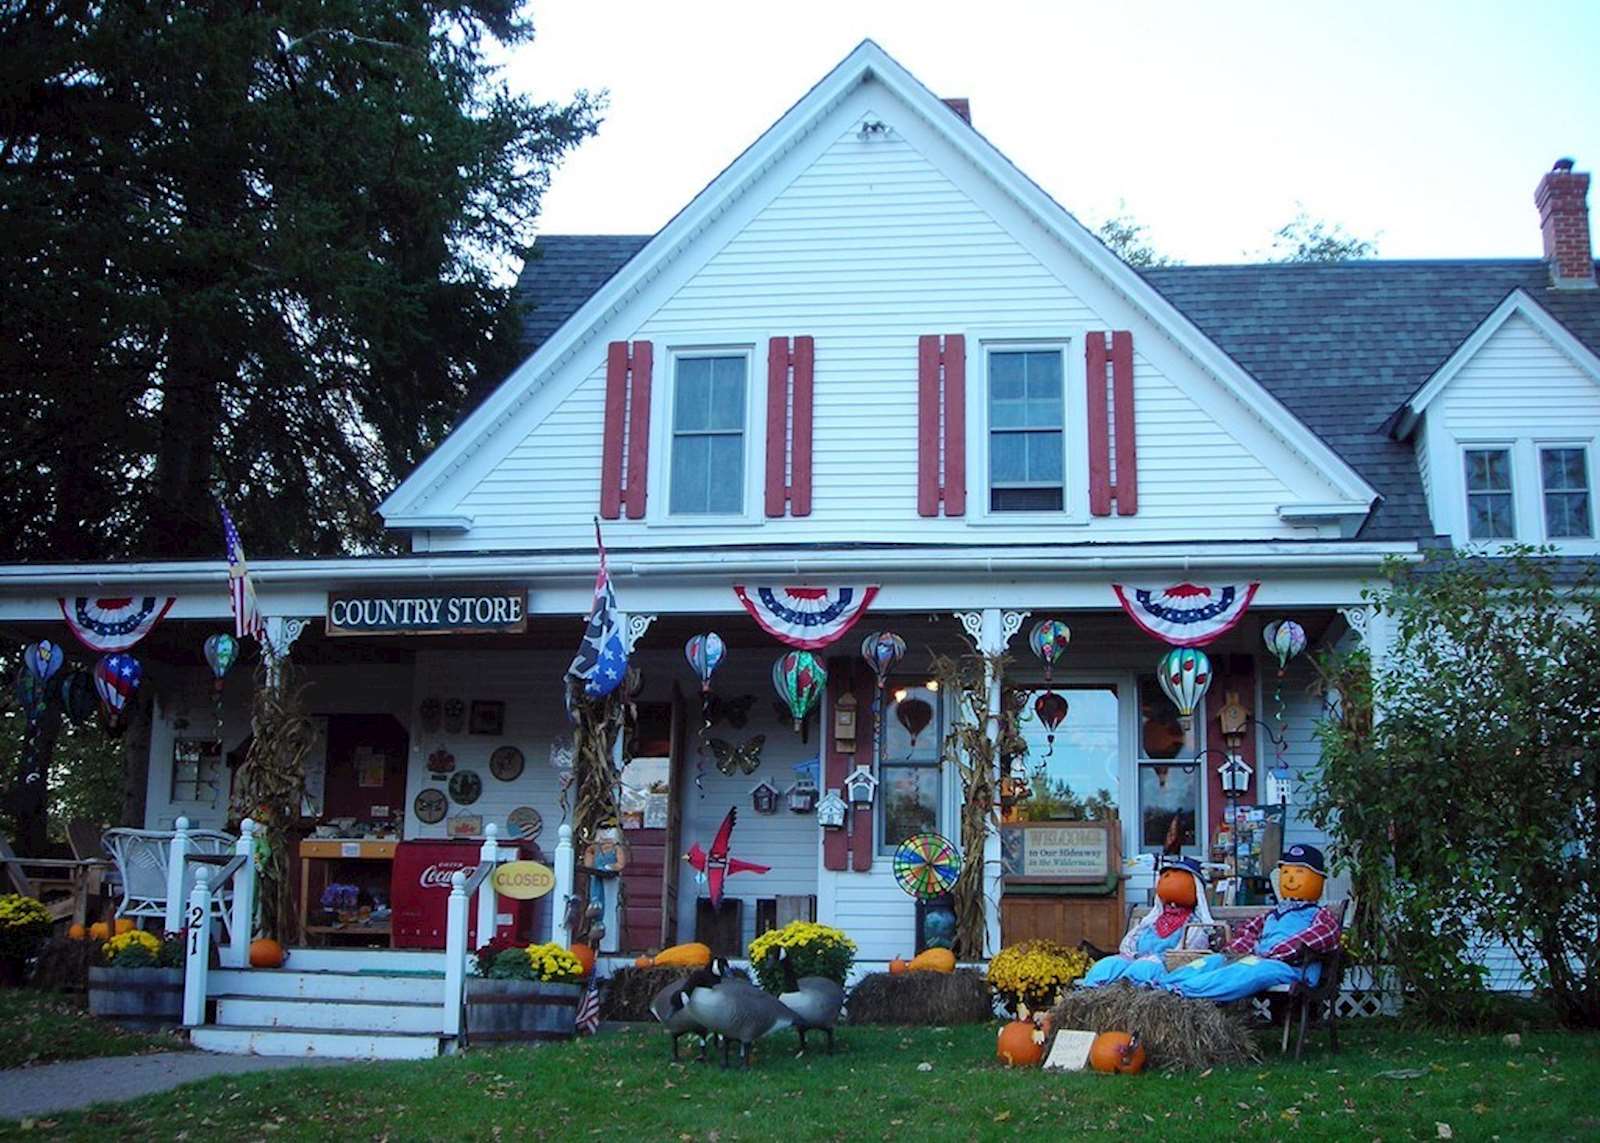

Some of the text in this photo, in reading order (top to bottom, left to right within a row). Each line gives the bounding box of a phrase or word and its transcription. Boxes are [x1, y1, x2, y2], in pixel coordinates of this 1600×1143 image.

[331, 597, 523, 625] COUNTRY STORE
[1039, 848, 1057, 857] Our
[1059, 847, 1102, 859] Hideaway
[496, 872, 550, 887] CLOSED
[189, 906, 204, 956] 21
